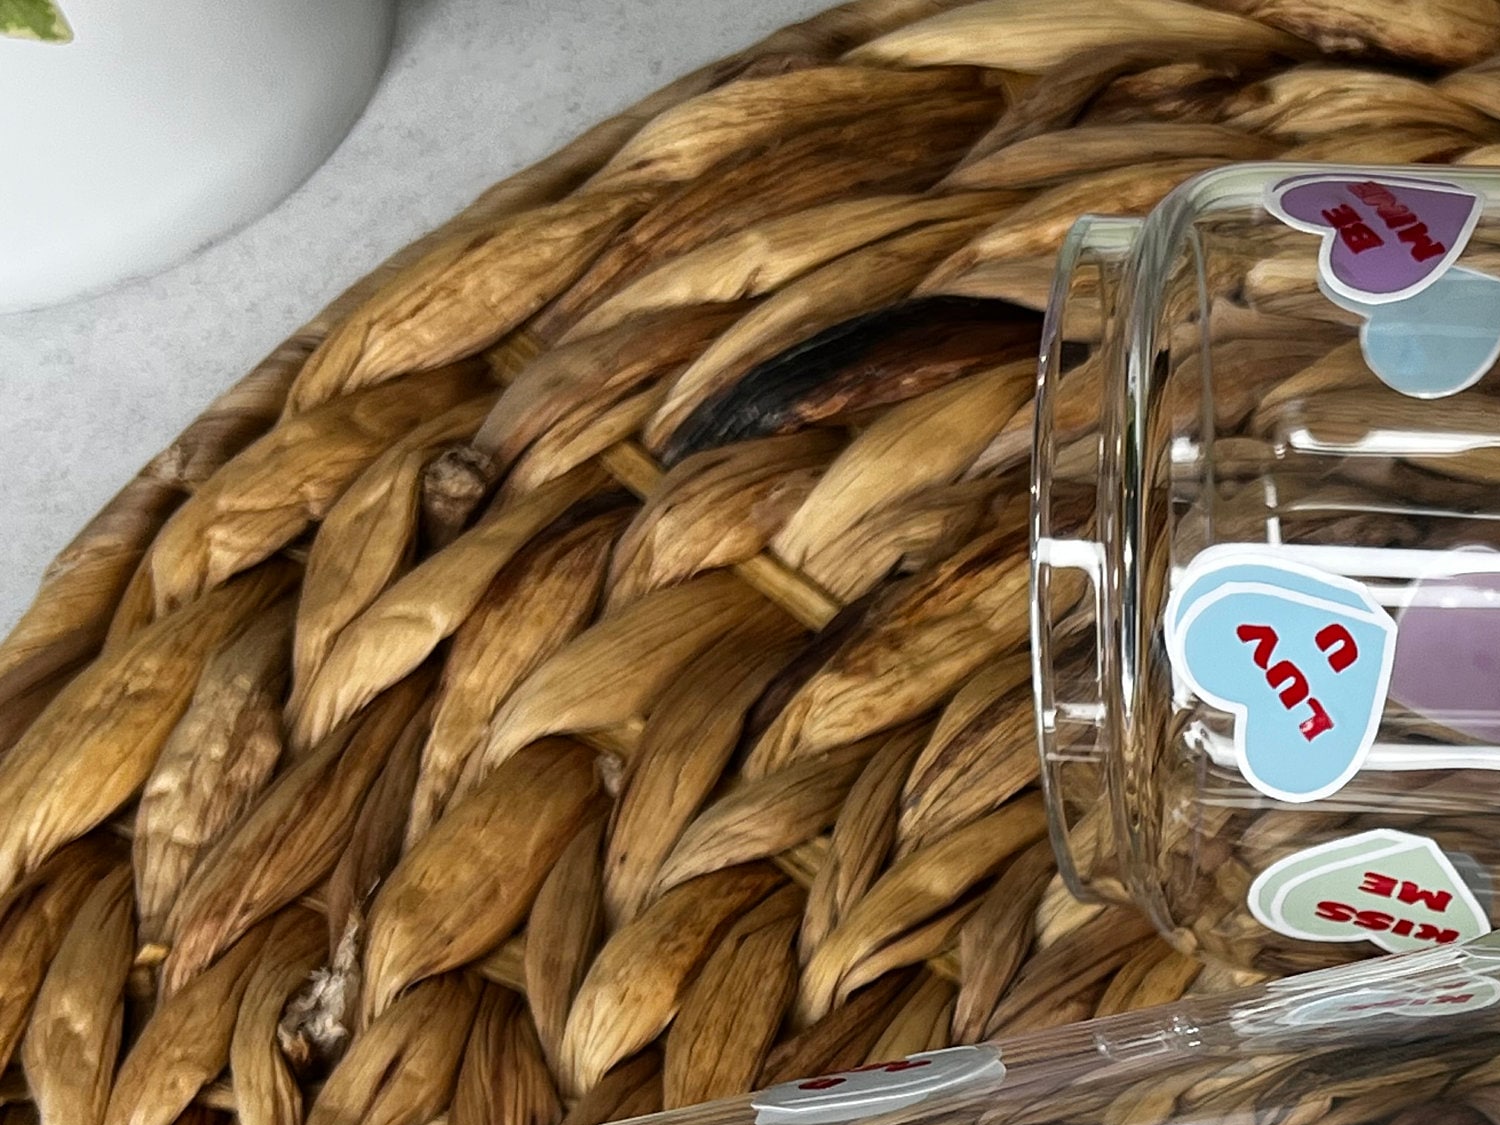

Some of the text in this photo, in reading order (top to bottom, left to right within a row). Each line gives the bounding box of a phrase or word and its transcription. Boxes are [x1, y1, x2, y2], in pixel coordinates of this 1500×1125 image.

[1321, 203, 1385, 255] BE
[1314, 622, 1358, 674] U
[1236, 623, 1334, 742] LUV
[1358, 871, 1453, 912] ME
[1314, 901, 1460, 944] KISS
